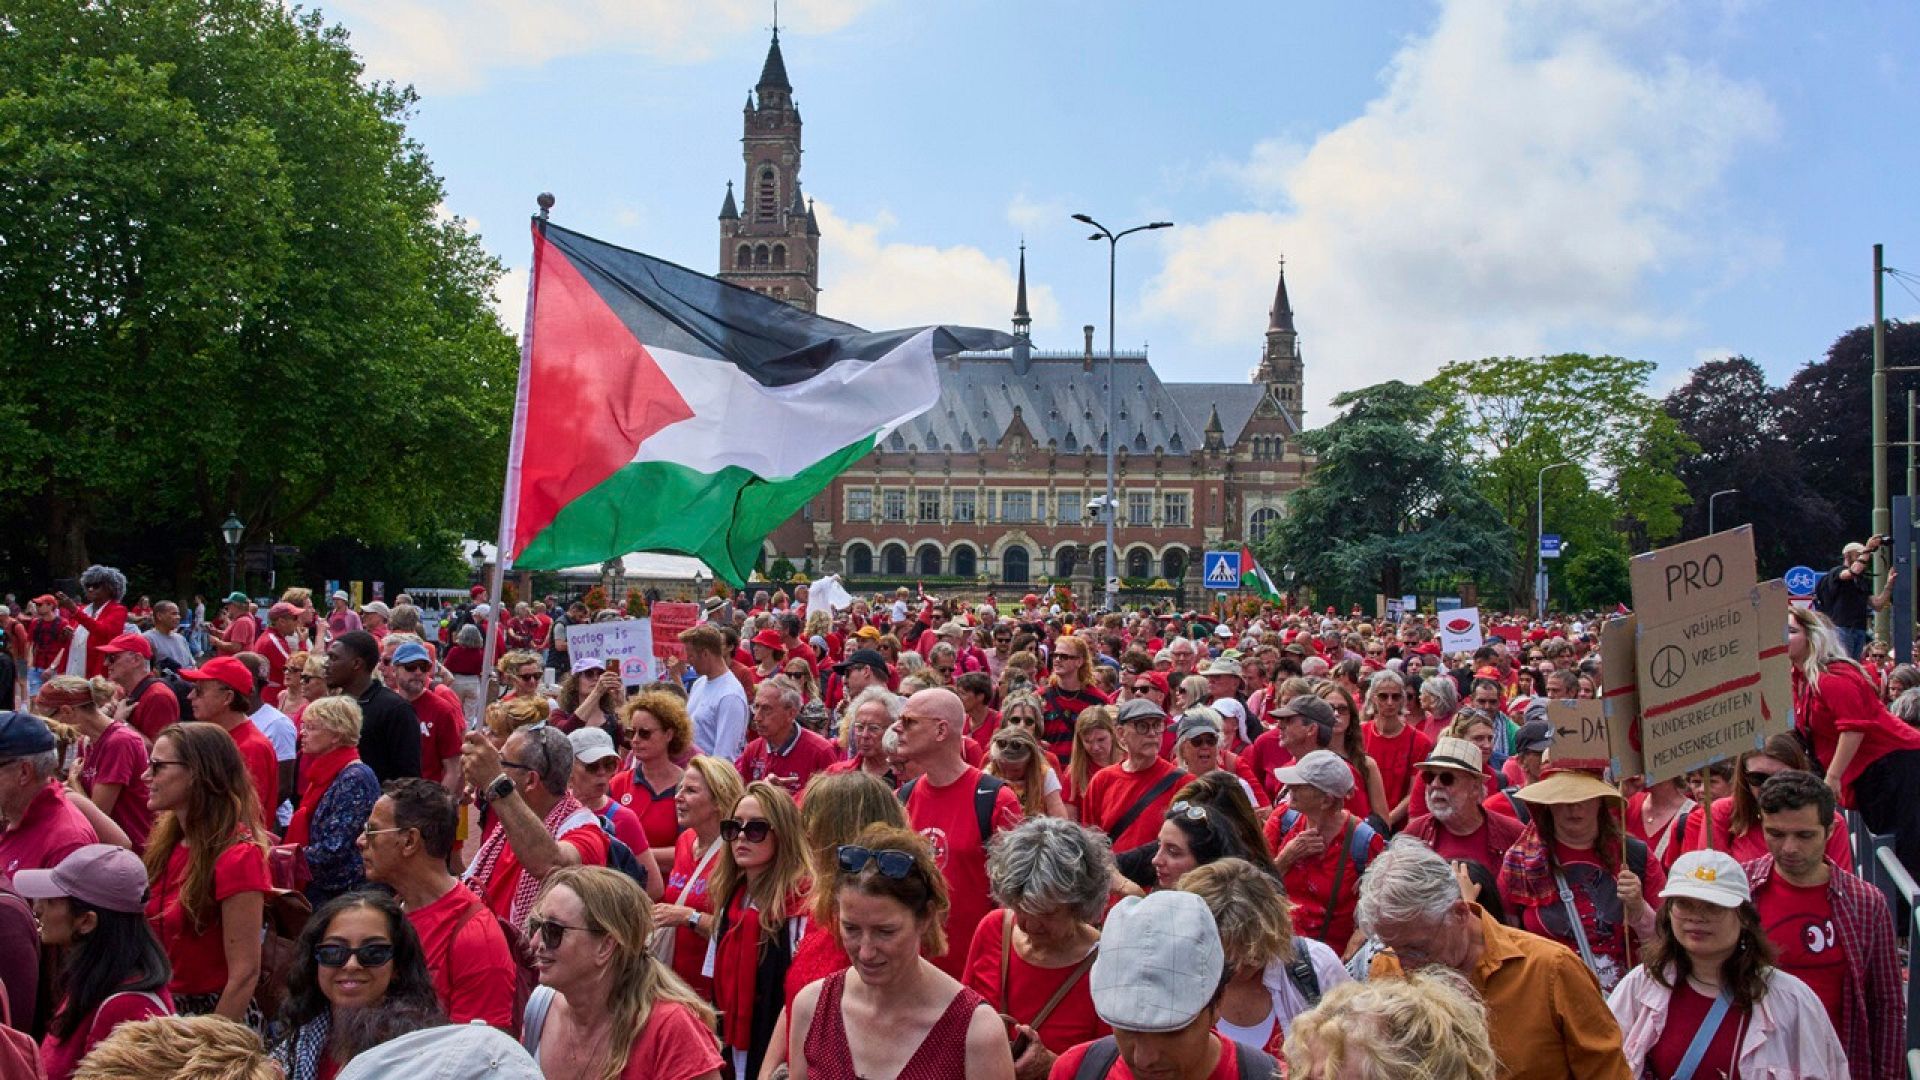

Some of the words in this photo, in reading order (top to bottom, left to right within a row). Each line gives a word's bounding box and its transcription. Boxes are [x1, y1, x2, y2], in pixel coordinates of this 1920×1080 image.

[1666, 554, 1723, 602] PRO
[615, 628, 628, 640] is
[1692, 640, 1740, 666] VREDE
[1651, 691, 1753, 739] KINDERRECHTEN
[1653, 717, 1755, 769] MENSENRECHTEN
